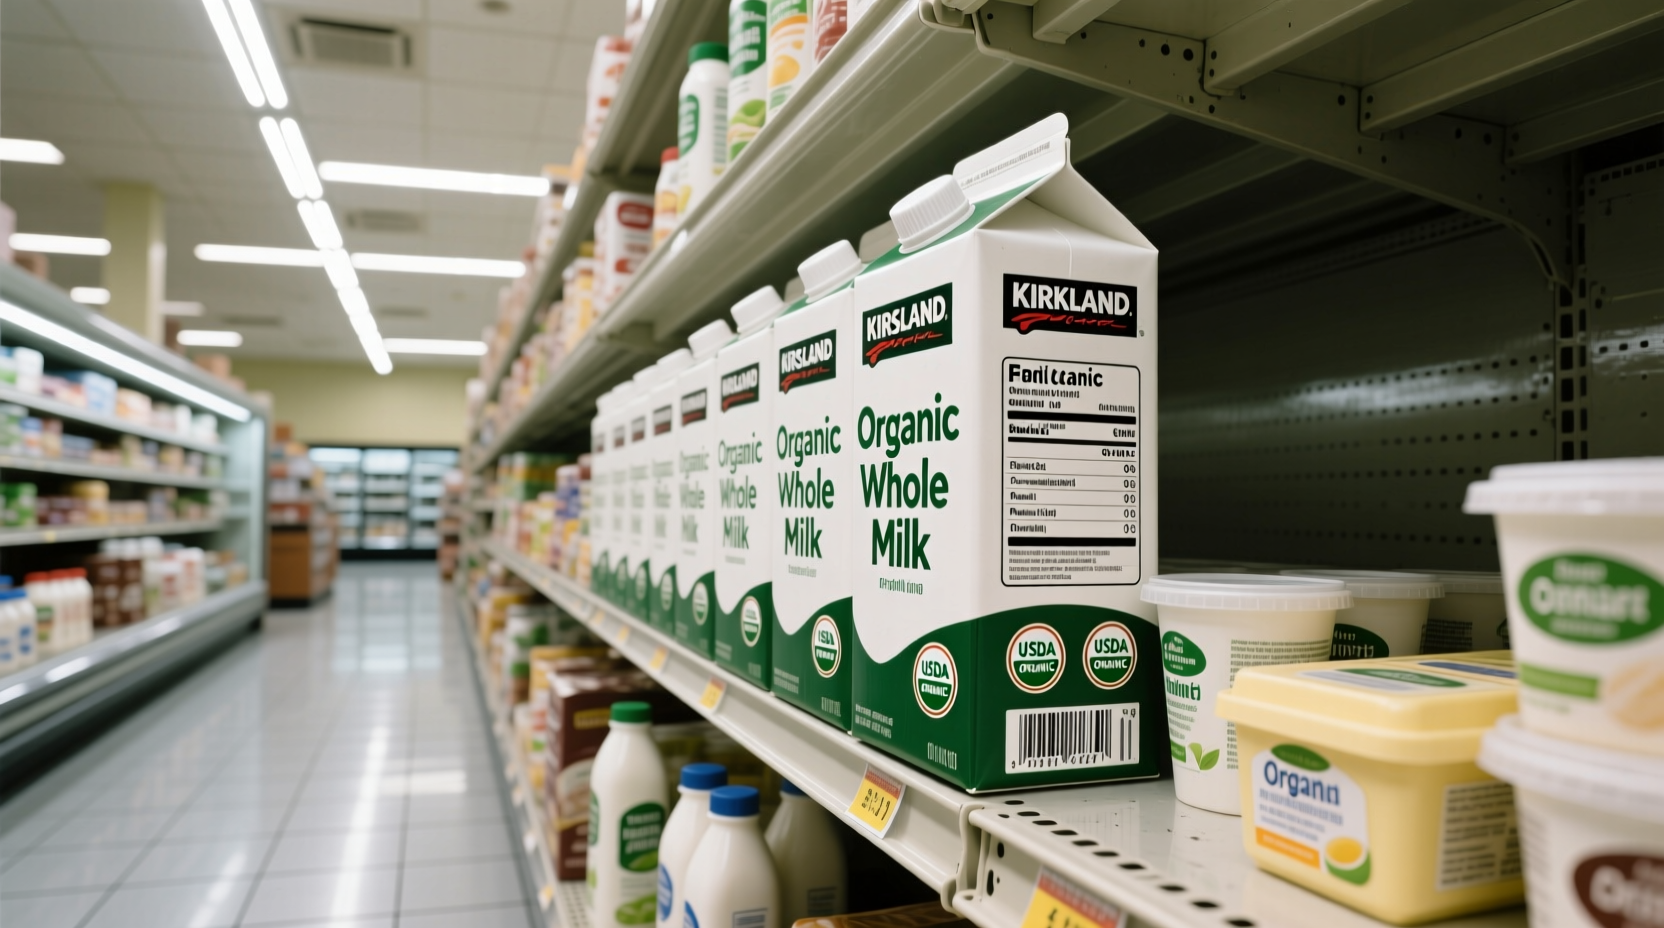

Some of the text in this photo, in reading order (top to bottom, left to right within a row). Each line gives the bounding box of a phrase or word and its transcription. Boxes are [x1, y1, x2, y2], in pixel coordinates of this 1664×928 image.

[776, 415, 842, 468] Organic
[857, 391, 960, 459] Organic
[718, 431, 763, 475] Organic
[719, 475, 757, 509] Whole
[778, 467, 835, 510] Whole
[860, 457, 949, 509] Whole
[723, 515, 749, 550] Milk
[784, 516, 823, 559] Milk
[871, 517, 931, 571] Milk
[1018, 641, 1057, 658] USDA
[1094, 637, 1129, 654] USDA
[921, 659, 950, 680] USDA
